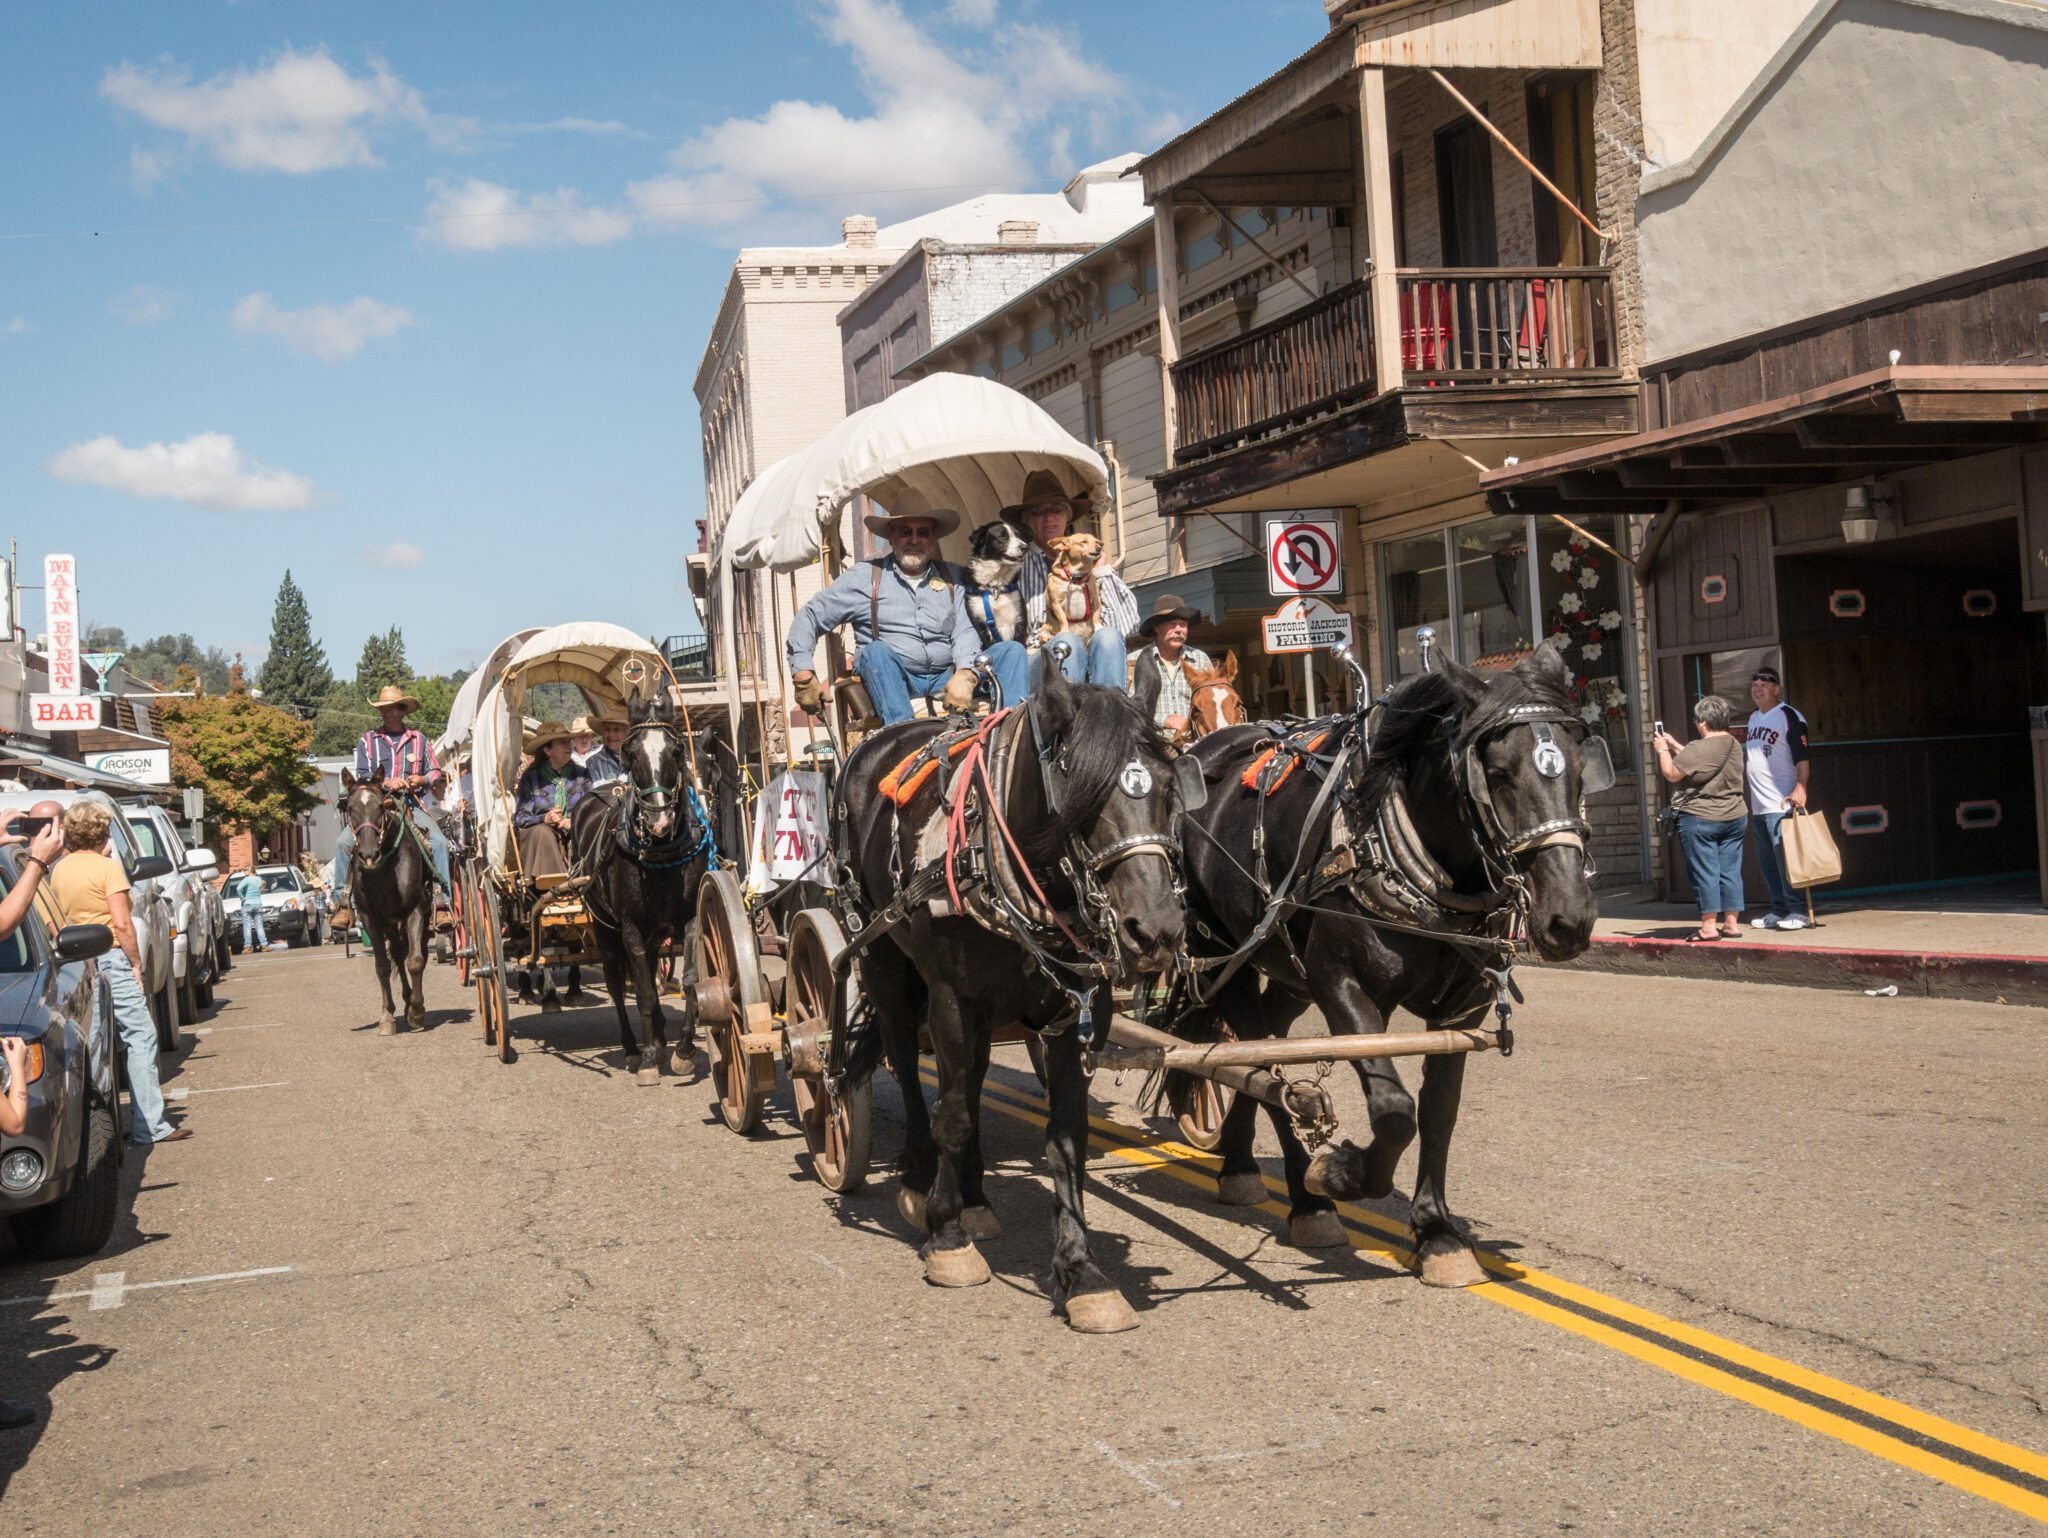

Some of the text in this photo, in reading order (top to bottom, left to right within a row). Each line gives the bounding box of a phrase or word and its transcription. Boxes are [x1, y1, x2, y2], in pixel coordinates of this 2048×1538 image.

[48, 560, 73, 689] MAIN EVENT
[1268, 618, 1348, 632] HISTORIC JACKSON
[1280, 633, 1336, 645] PARKING
[37, 703, 95, 721] BAR
[1747, 726, 1778, 744] IANTS
[104, 758, 152, 769] JACKSON
